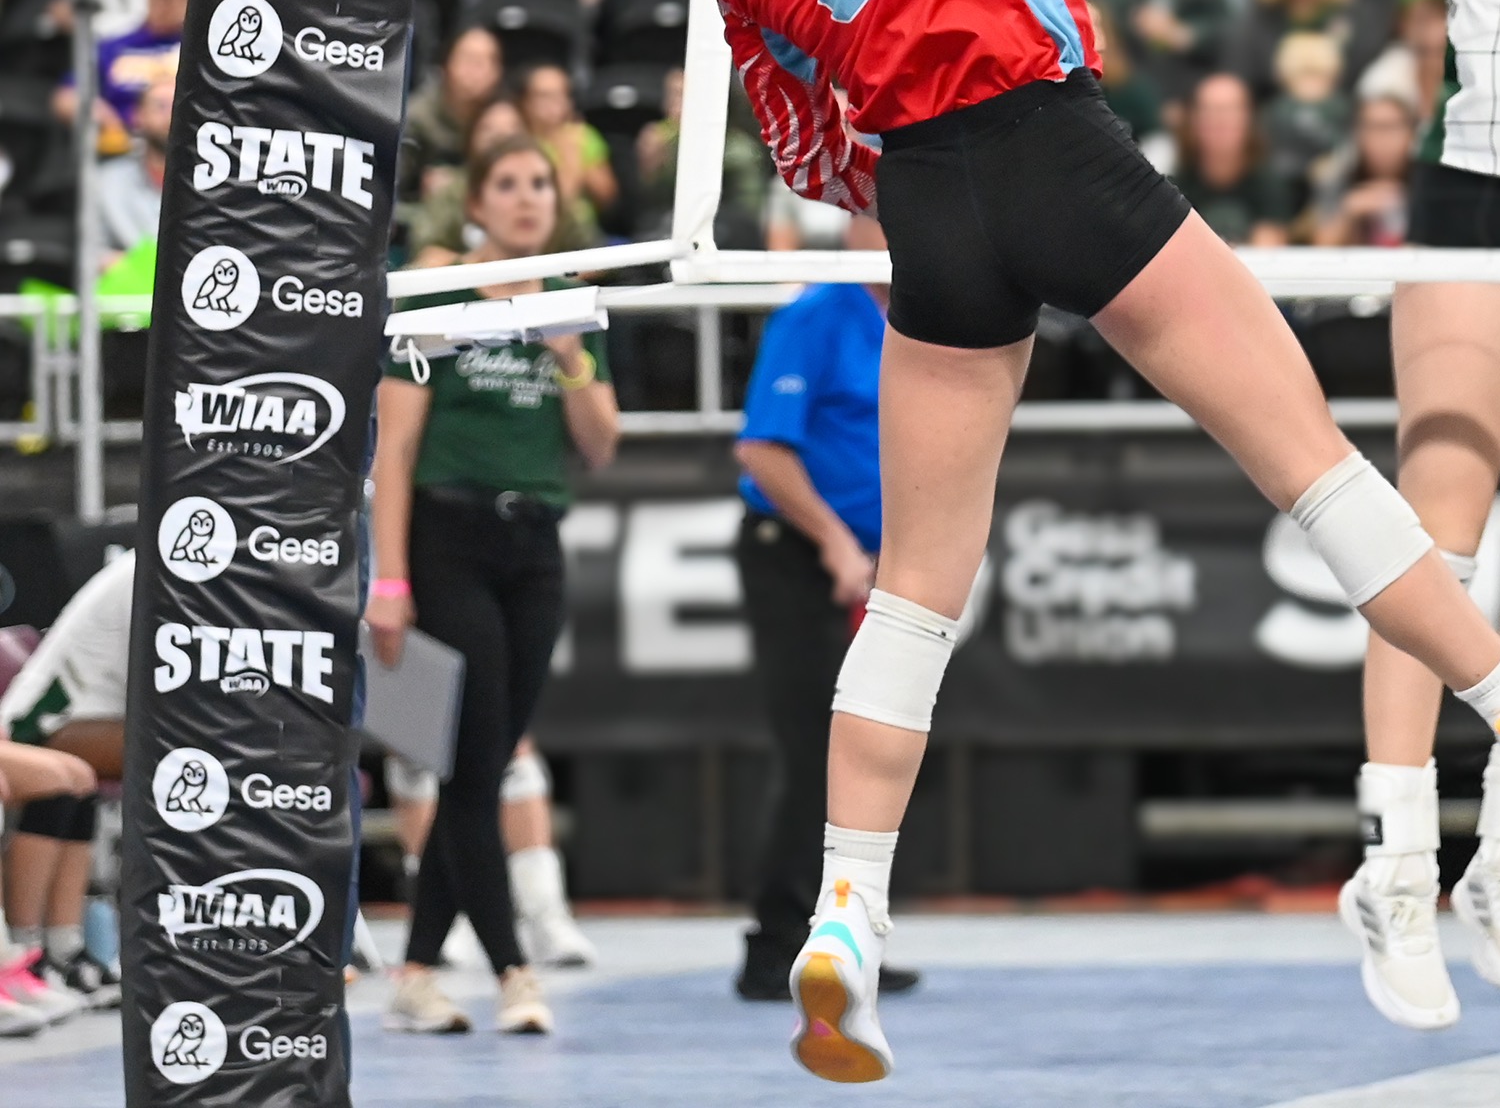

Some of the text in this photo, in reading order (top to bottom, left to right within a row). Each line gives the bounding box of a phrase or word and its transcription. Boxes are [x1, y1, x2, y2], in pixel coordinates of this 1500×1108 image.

[294, 26, 385, 72] Gesa
[193, 121, 375, 211] STATE
[271, 275, 364, 318] Gesa
[201, 391, 317, 436] WIAA
[248, 525, 340, 566] Gesa
[154, 622, 335, 704] STATE
[240, 772, 333, 812] Gesa
[183, 891, 298, 930] WIAA
[238, 1025, 328, 1061] Gesa
